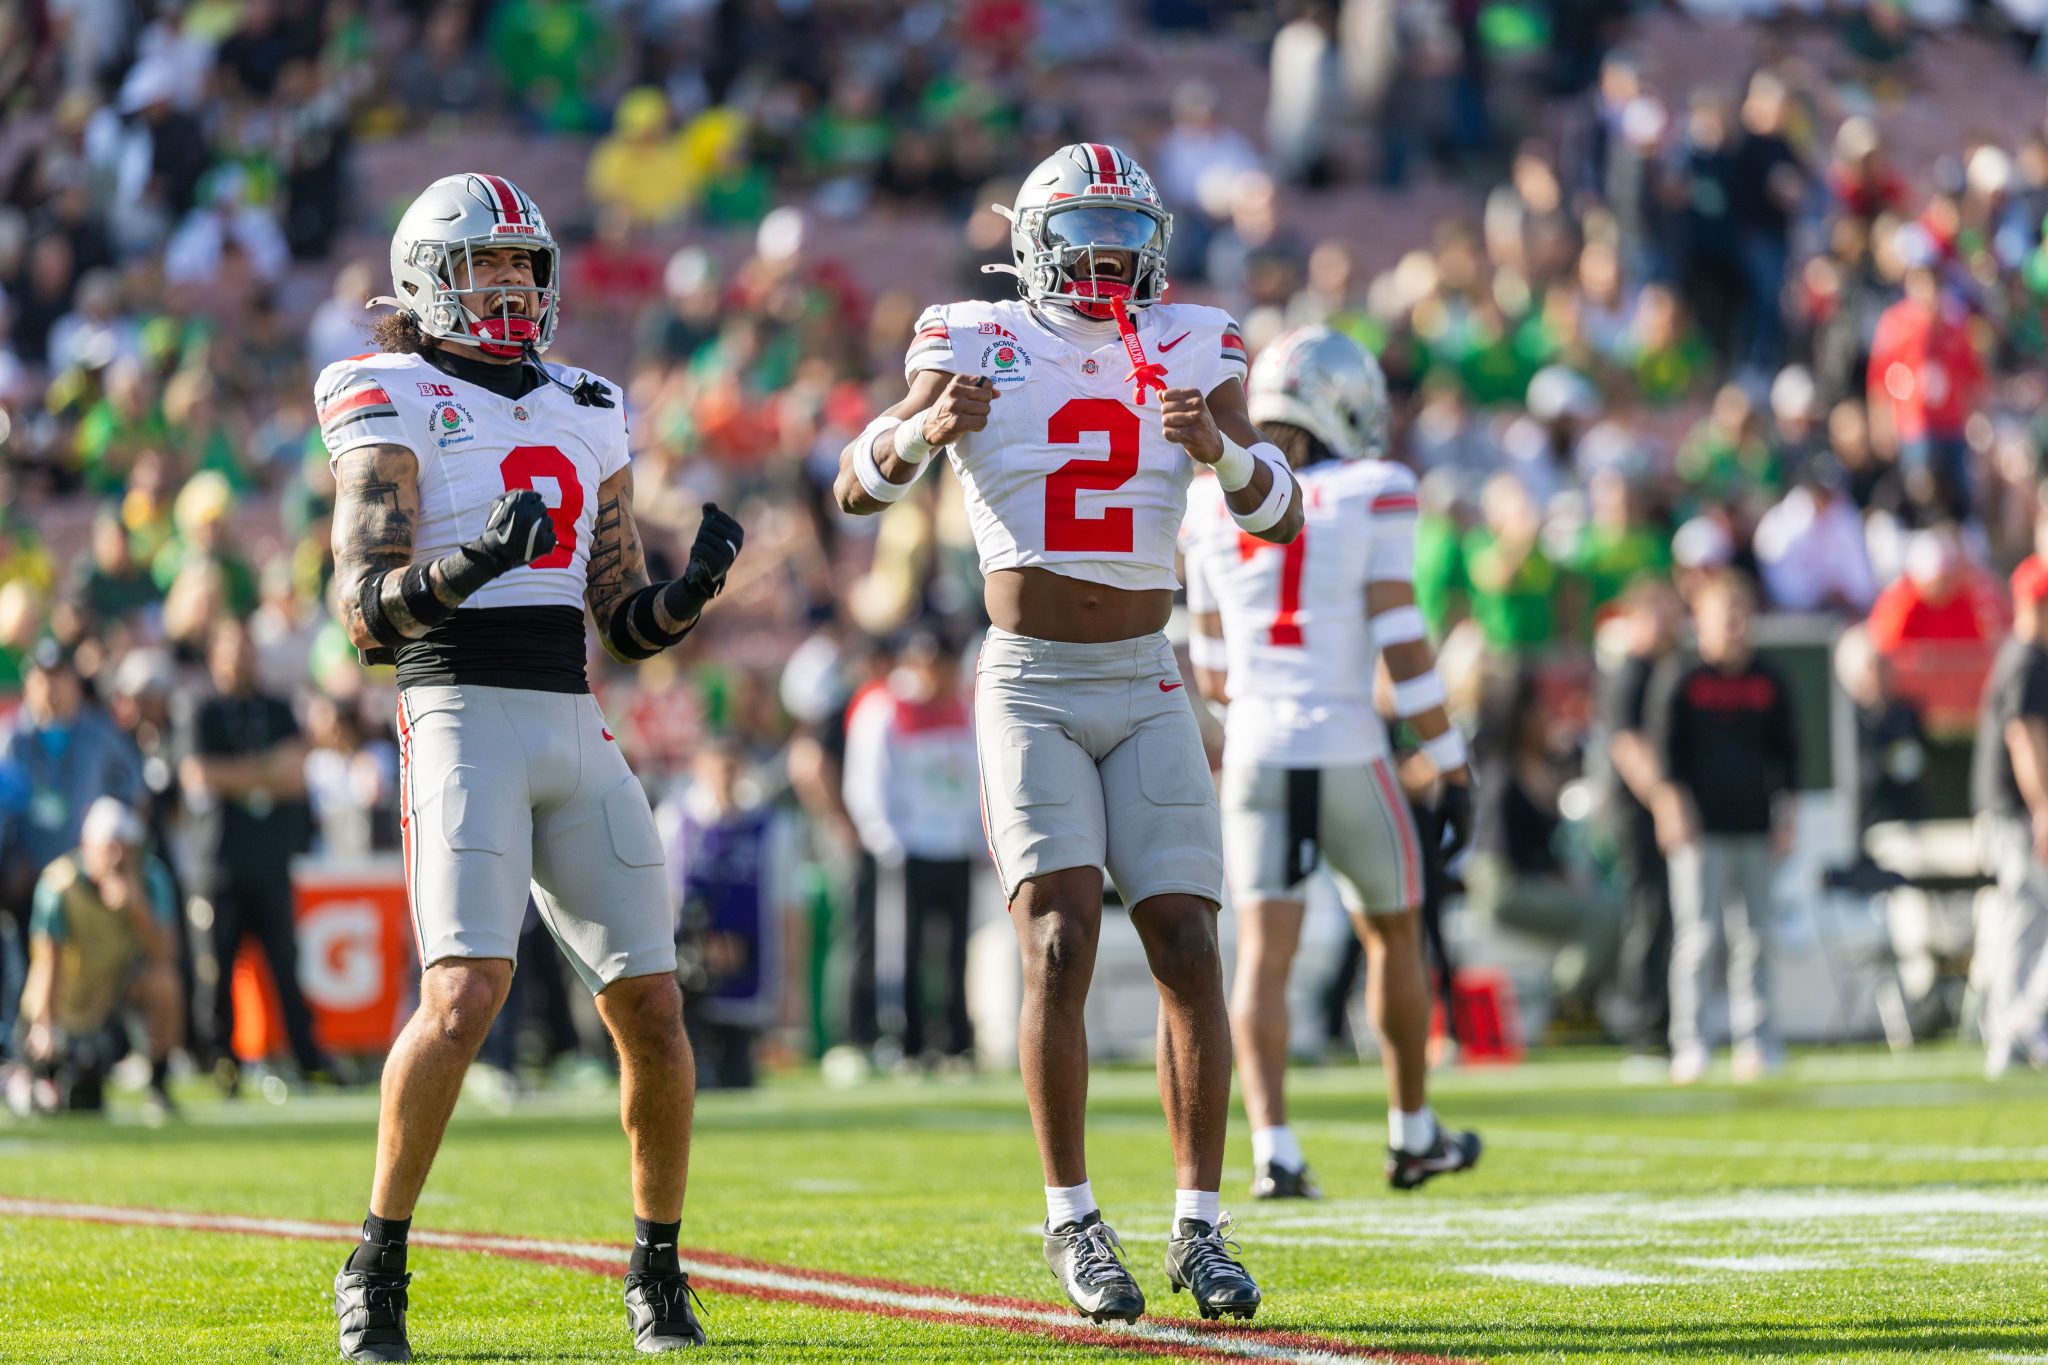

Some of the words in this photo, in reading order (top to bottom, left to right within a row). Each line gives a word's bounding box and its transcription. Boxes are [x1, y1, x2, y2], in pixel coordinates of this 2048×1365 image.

[1090, 186, 1108, 195] OHIO
[1110, 186, 1132, 196] STATE
[497, 225, 515, 234] OHIO
[516, 225, 535, 234] STATE
[981, 346, 993, 368] ROSE
[992, 340, 1016, 349] BOWL
[1017, 346, 1032, 367] GAME
[1124, 333, 1145, 364] NXTRND
[997, 375, 1026, 383] Prudential
[429, 408, 438, 432] ROSE
[435, 400, 455, 410] BOWL
[455, 403, 475, 424] GAME
[448, 435, 474, 445] Prudential
[1044, 398, 1140, 553] 2
[297, 901, 385, 1012] G
